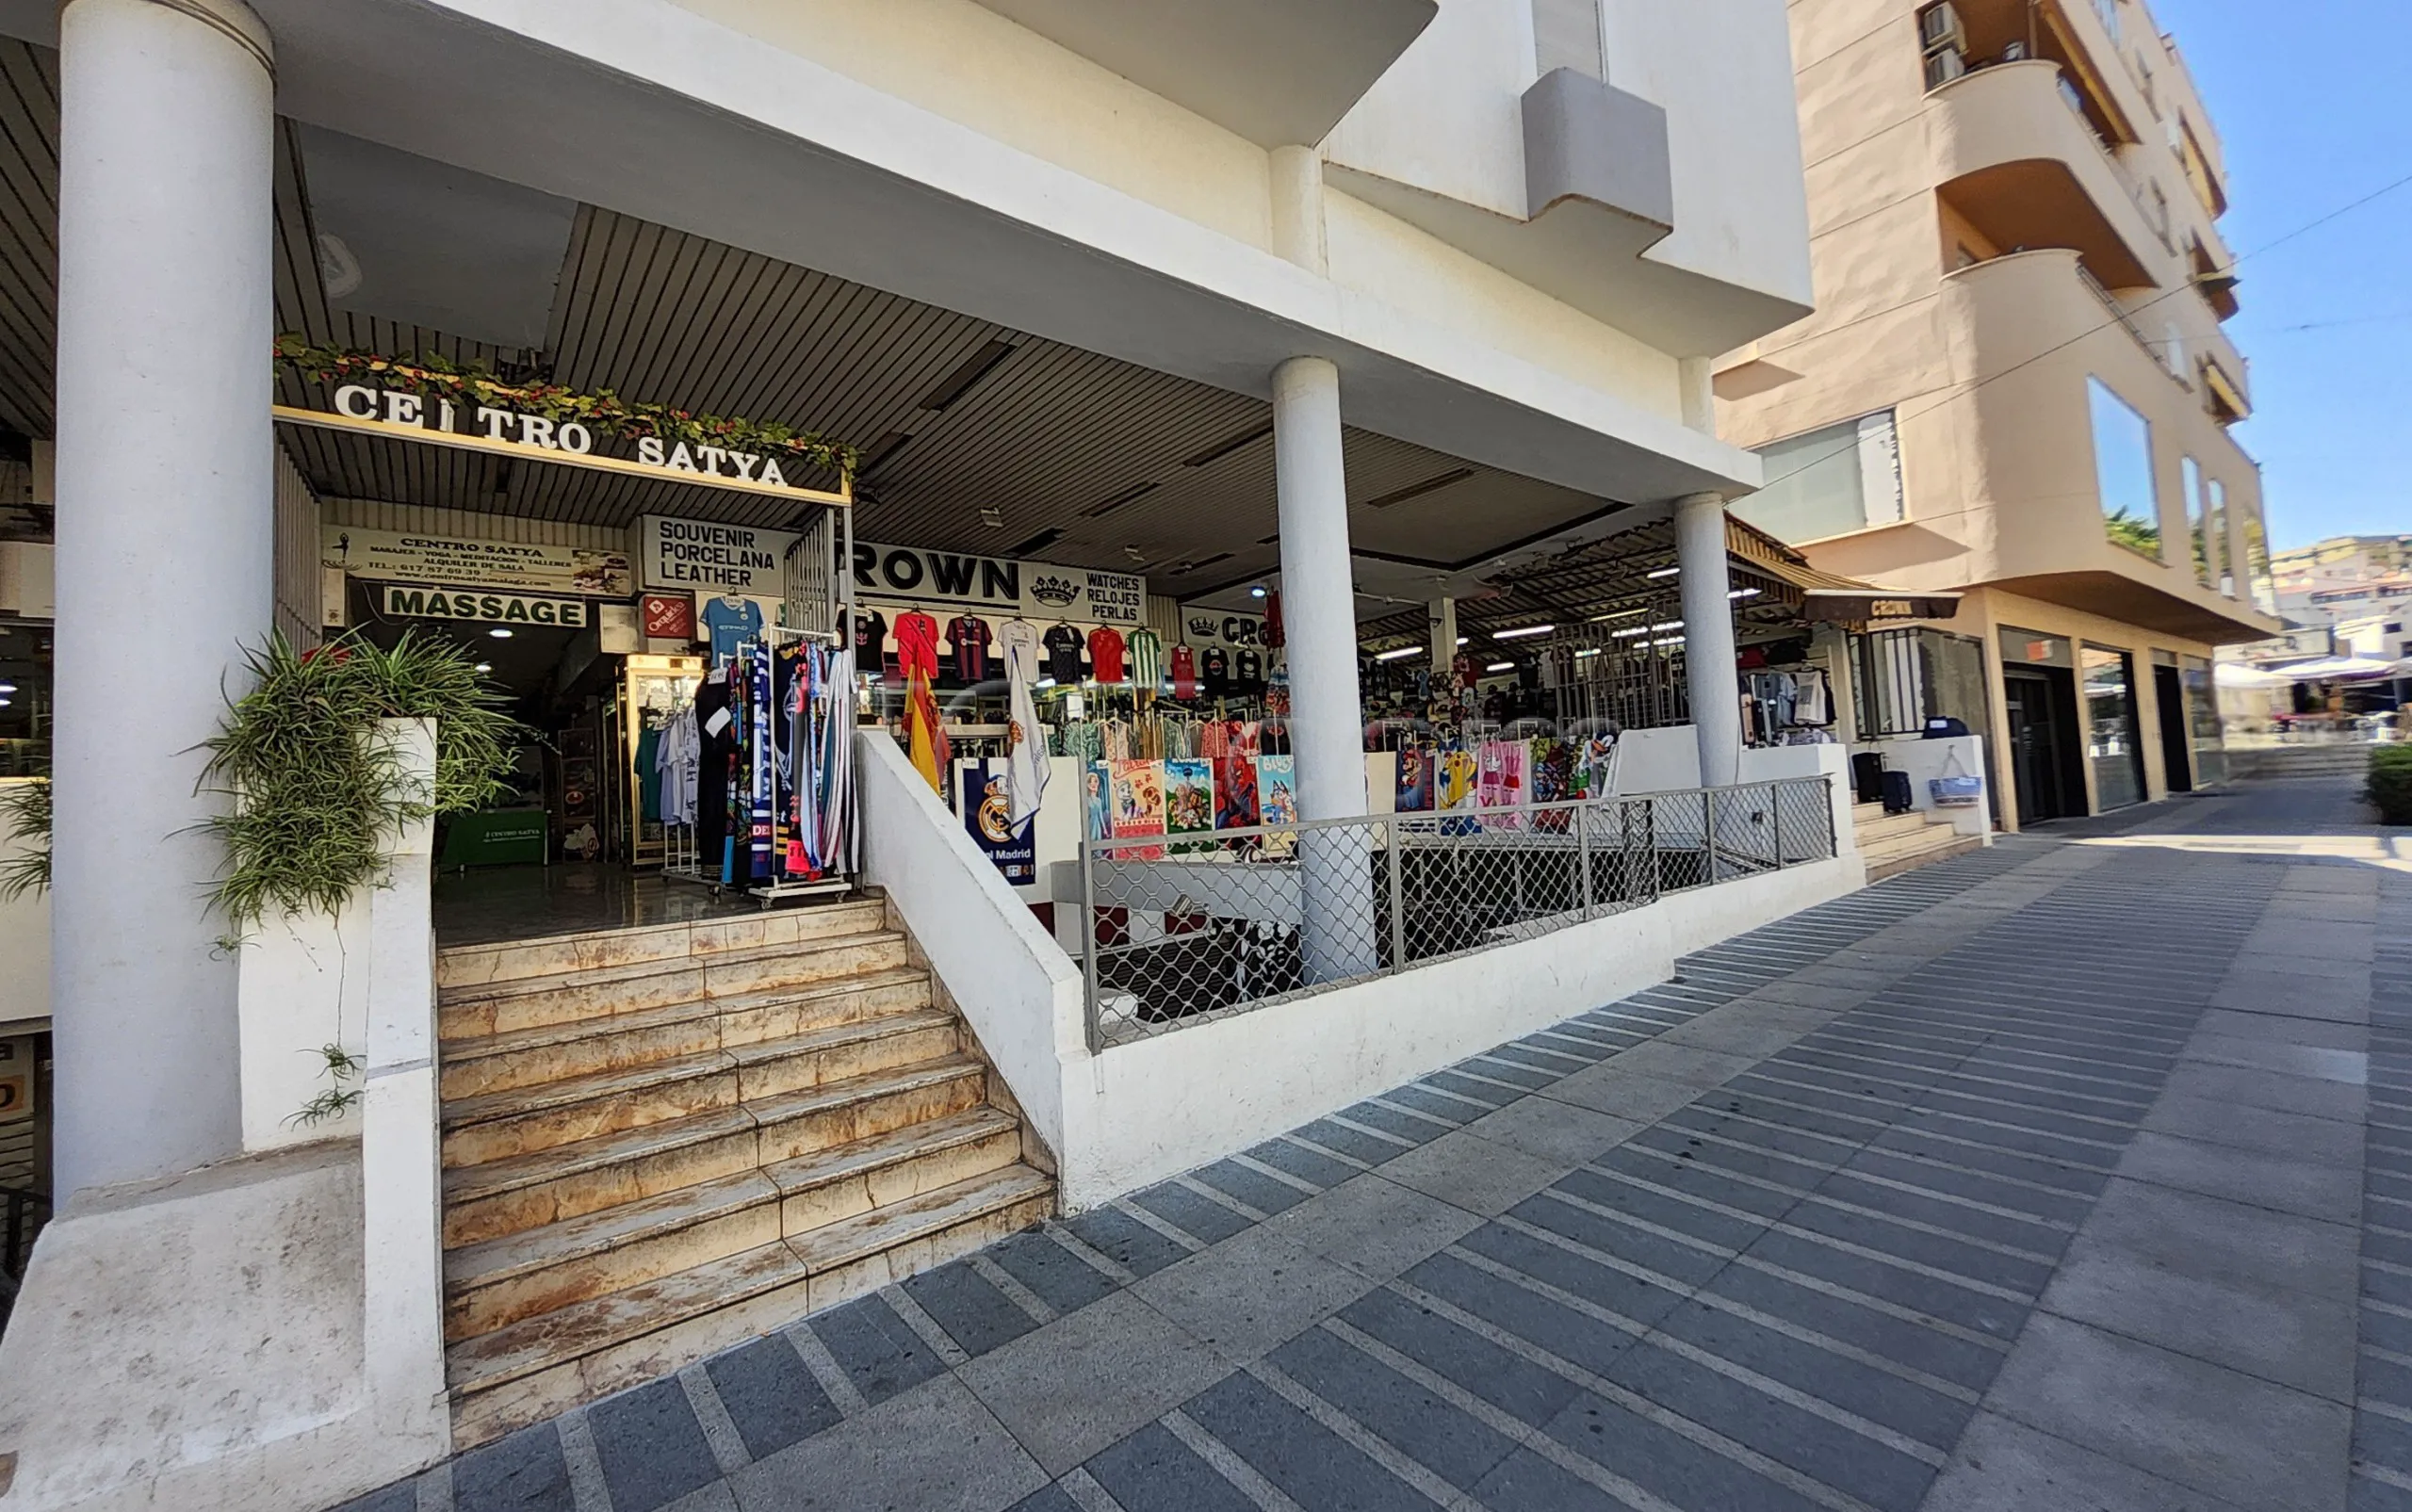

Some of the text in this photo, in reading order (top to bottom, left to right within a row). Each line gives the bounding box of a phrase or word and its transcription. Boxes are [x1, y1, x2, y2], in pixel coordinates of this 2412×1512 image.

[334, 385, 788, 488] CETRO SATYA
[660, 521, 755, 548] SOUVENIR
[400, 538, 545, 558] CENTRO SATYA
[424, 550, 452, 559] YOGA
[660, 542, 774, 570] PORCELANA
[423, 558, 478, 567] ALQUILER
[835, 541, 1019, 600] ROWN
[660, 562, 752, 586] LEATHER
[1086, 573, 1139, 591] WATCHES
[1086, 588, 1140, 607] RELOJES
[390, 590, 582, 626] MASSAGE
[1092, 605, 1137, 621] PERLAS
[995, 848, 1031, 859] Madrid
